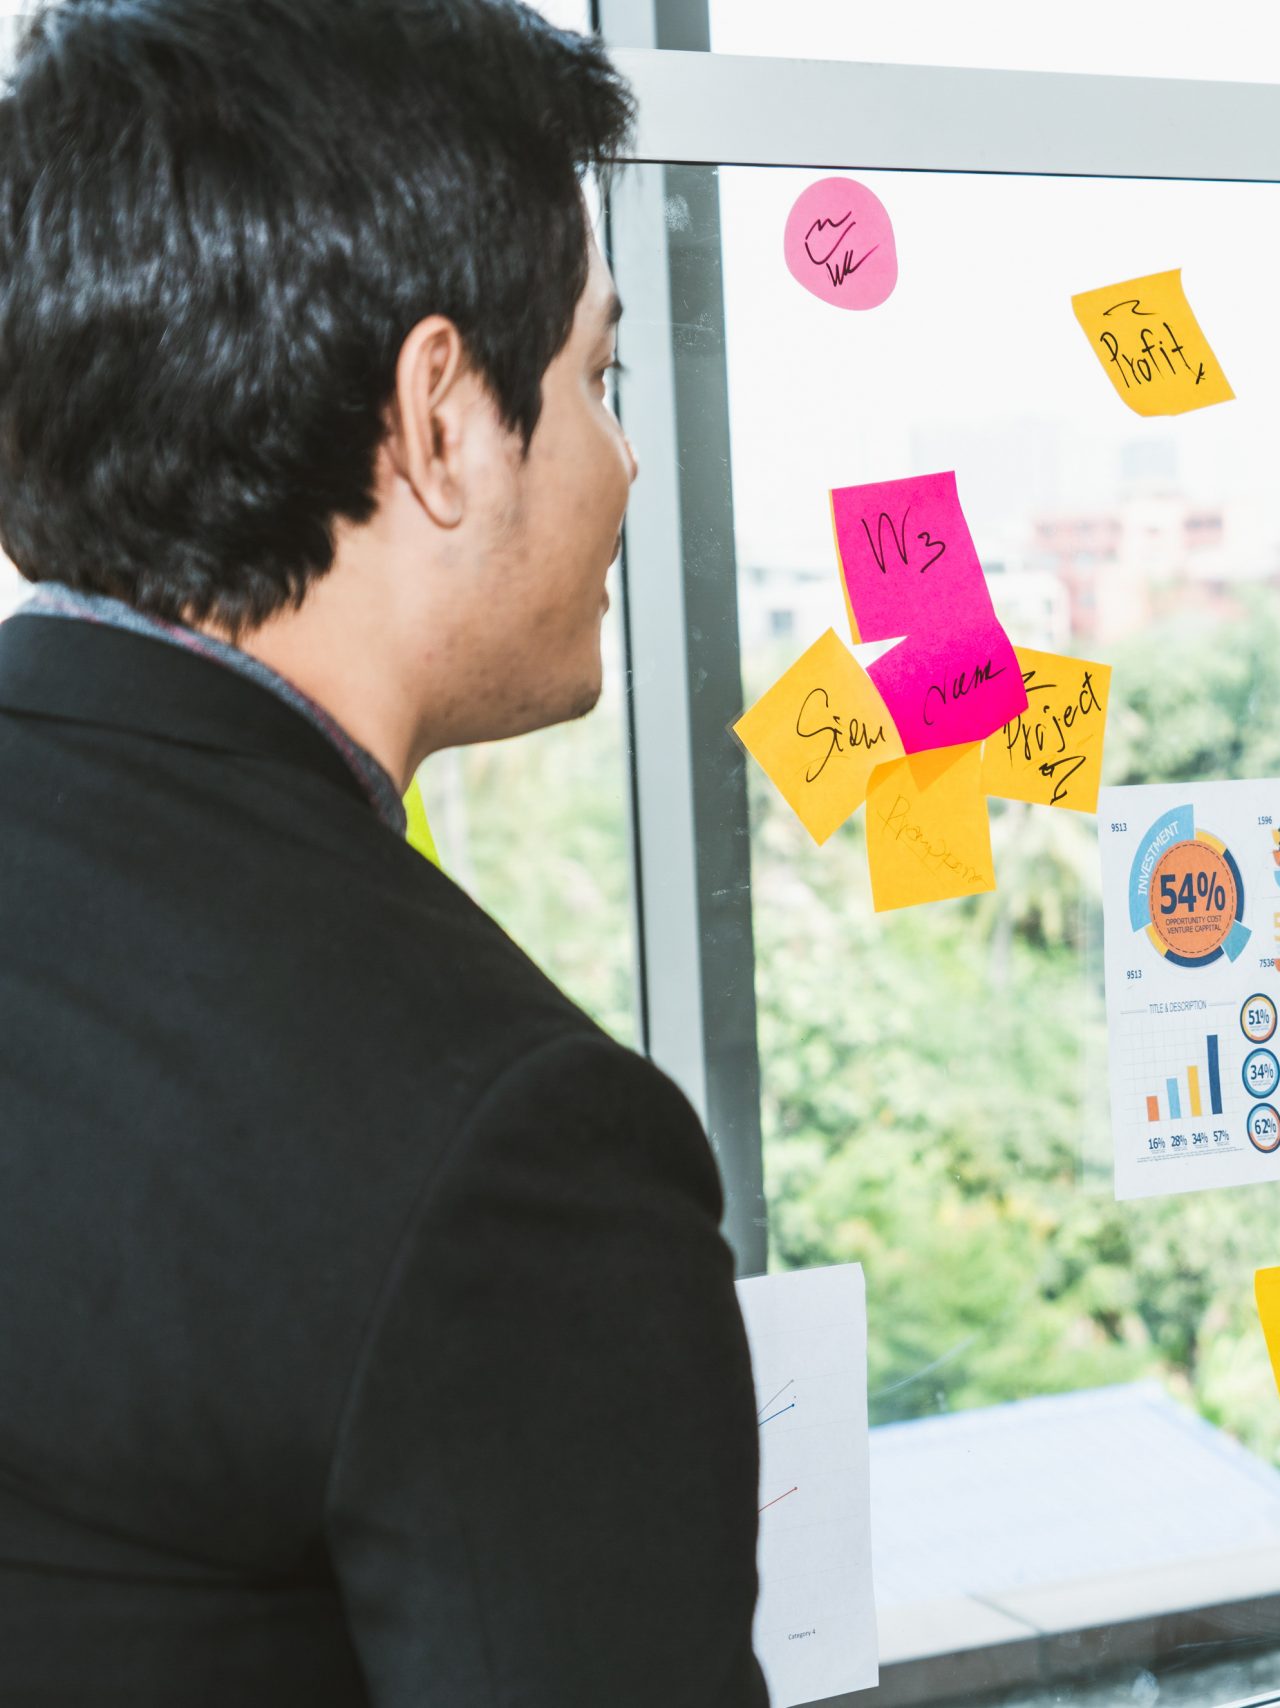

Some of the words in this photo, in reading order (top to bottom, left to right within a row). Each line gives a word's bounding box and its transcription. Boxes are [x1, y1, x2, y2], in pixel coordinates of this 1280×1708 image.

[1002, 670, 1102, 766] Project
[1257, 816, 1273, 825] 1596
[1111, 822, 1128, 833] 9513
[1137, 820, 1181, 897] INVESTMENT
[1159, 871, 1226, 915] 54%
[1165, 916, 1205, 926] OPPORTUNITY
[1206, 914, 1222, 923] COST
[1167, 925, 1193, 935] VENTURE
[1127, 970, 1142, 980] 9513
[1149, 1003, 1164, 1014] TITLE
[1169, 1000, 1207, 1013] DESCRIPTION
[1248, 1009, 1270, 1025] 51%
[1250, 1063, 1274, 1081] 34%
[1255, 1117, 1277, 1135] 62%
[1171, 1135, 1188, 1147] 28%
[1192, 1132, 1208, 1144] 34%
[1213, 1130, 1230, 1142] 57%
[1148, 1137, 1166, 1149] 16%
